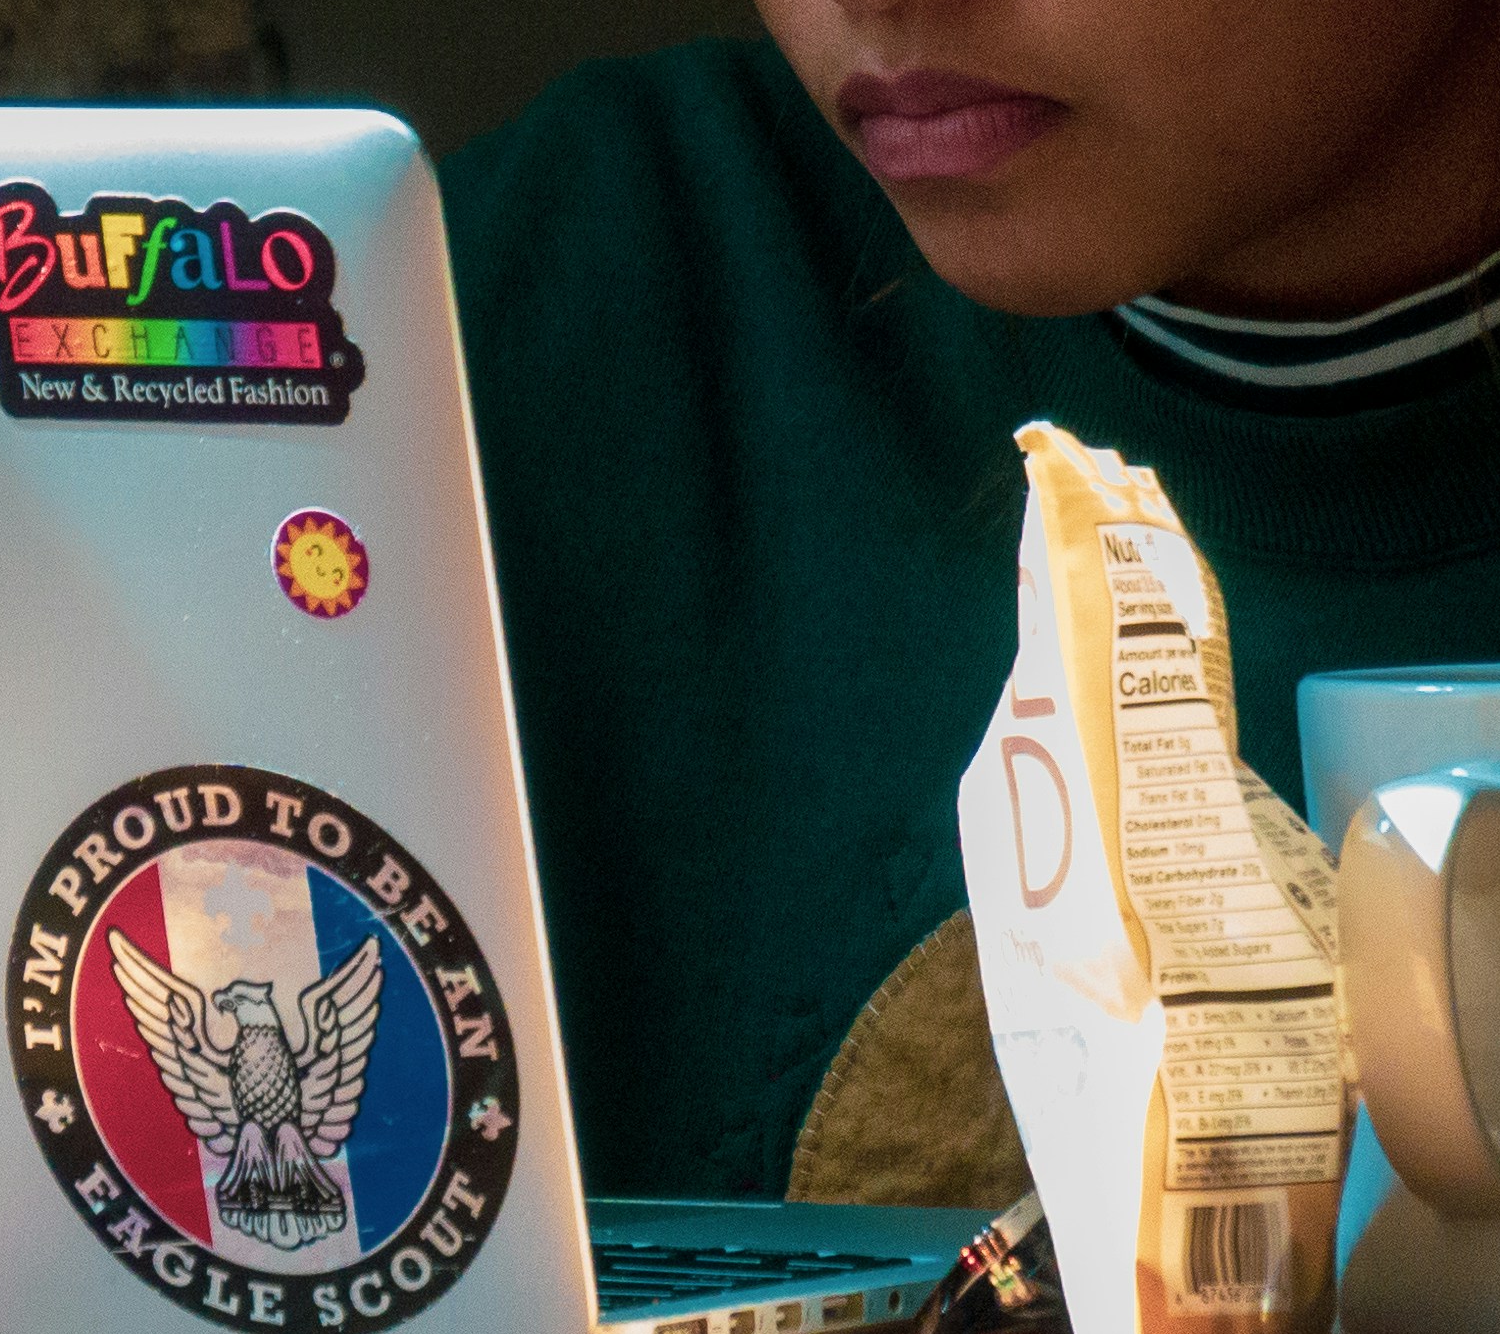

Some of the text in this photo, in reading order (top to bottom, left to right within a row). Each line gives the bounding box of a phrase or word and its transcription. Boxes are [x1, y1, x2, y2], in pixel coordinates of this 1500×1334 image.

[16, 320, 315, 366] EXCHANGE
[20, 372, 331, 409] New & Recycled Fashion
[1118, 669, 1200, 697] Calories
[1123, 739, 1152, 753] Total
[1155, 866, 1238, 883] Carbohydrate
[23, 783, 499, 1062] I'M PROUD TO BE AN
[74, 1162, 490, 1329] EAGLE SCOUT
